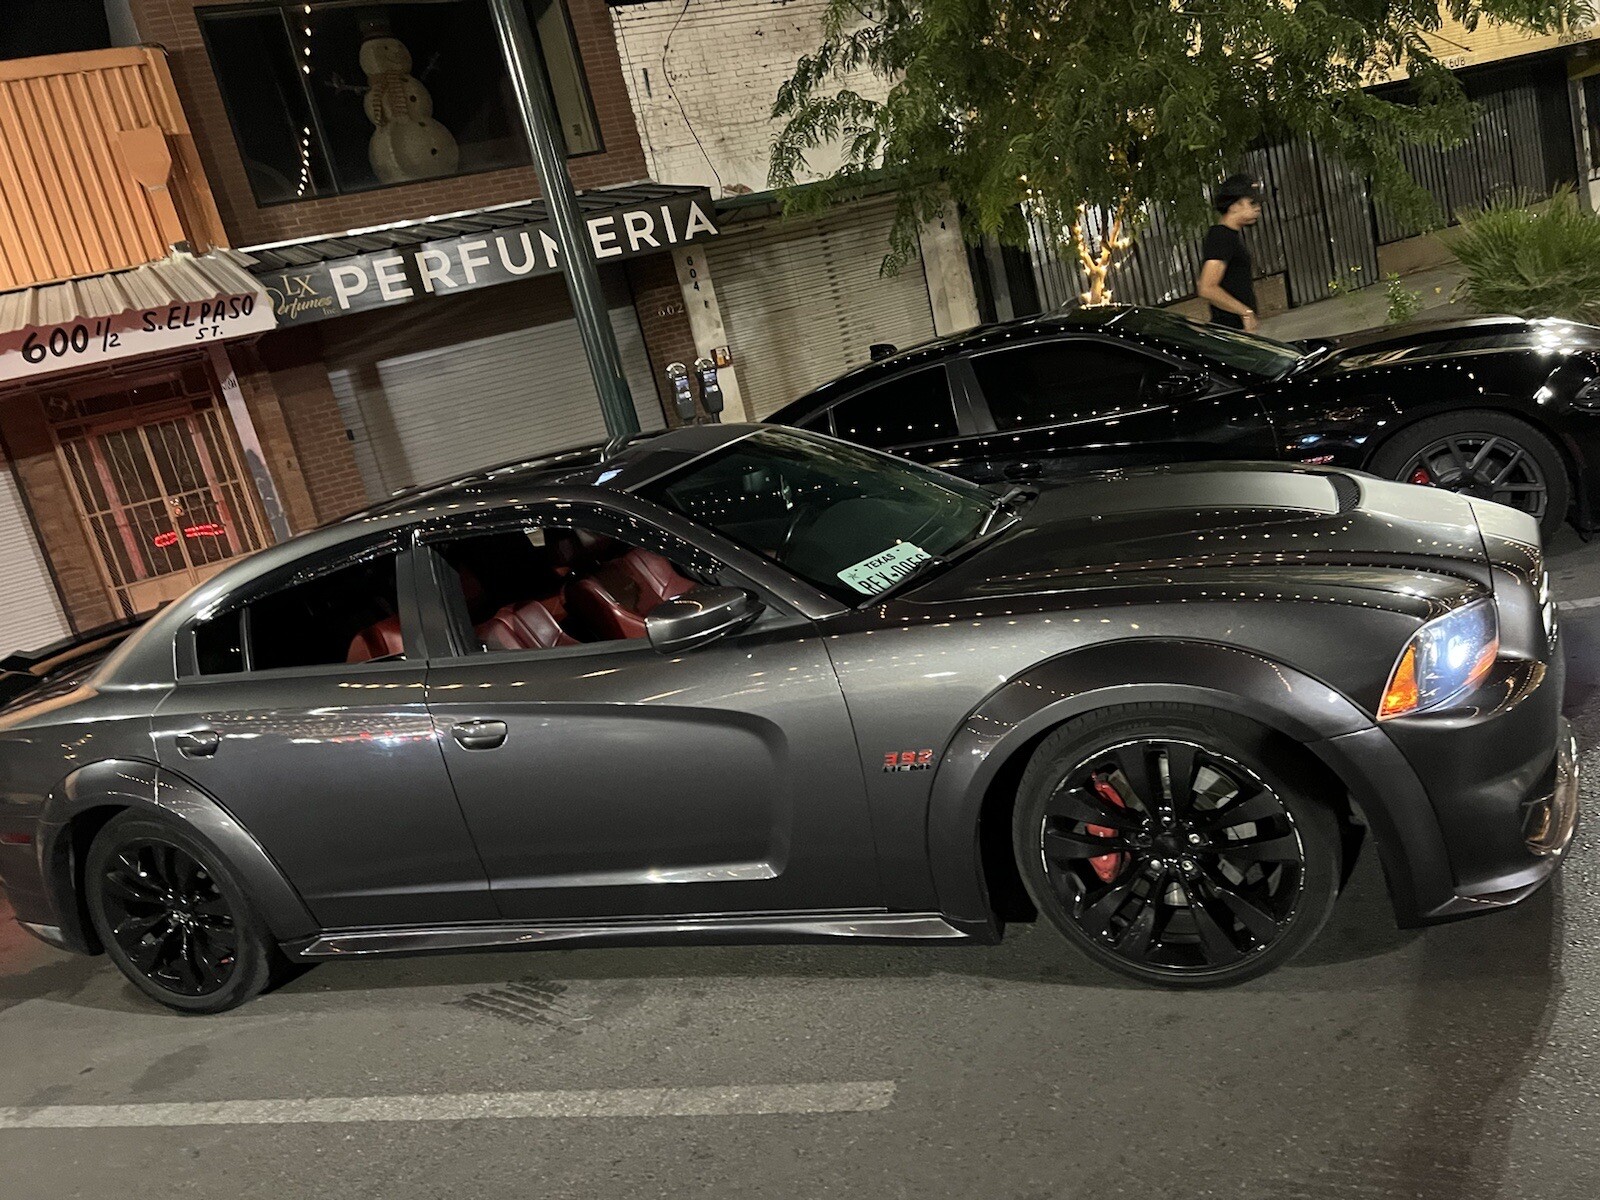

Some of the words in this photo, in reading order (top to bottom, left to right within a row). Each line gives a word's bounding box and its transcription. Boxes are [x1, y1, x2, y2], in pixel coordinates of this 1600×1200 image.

[686, 256, 700, 291] 604
[279, 274, 320, 298] LX
[657, 303, 685, 317] 602
[195, 325, 224, 340] ST.
[22, 323, 89, 364] 600
[863, 553, 896, 570] TEXAS
[884, 750, 933, 766] 392
